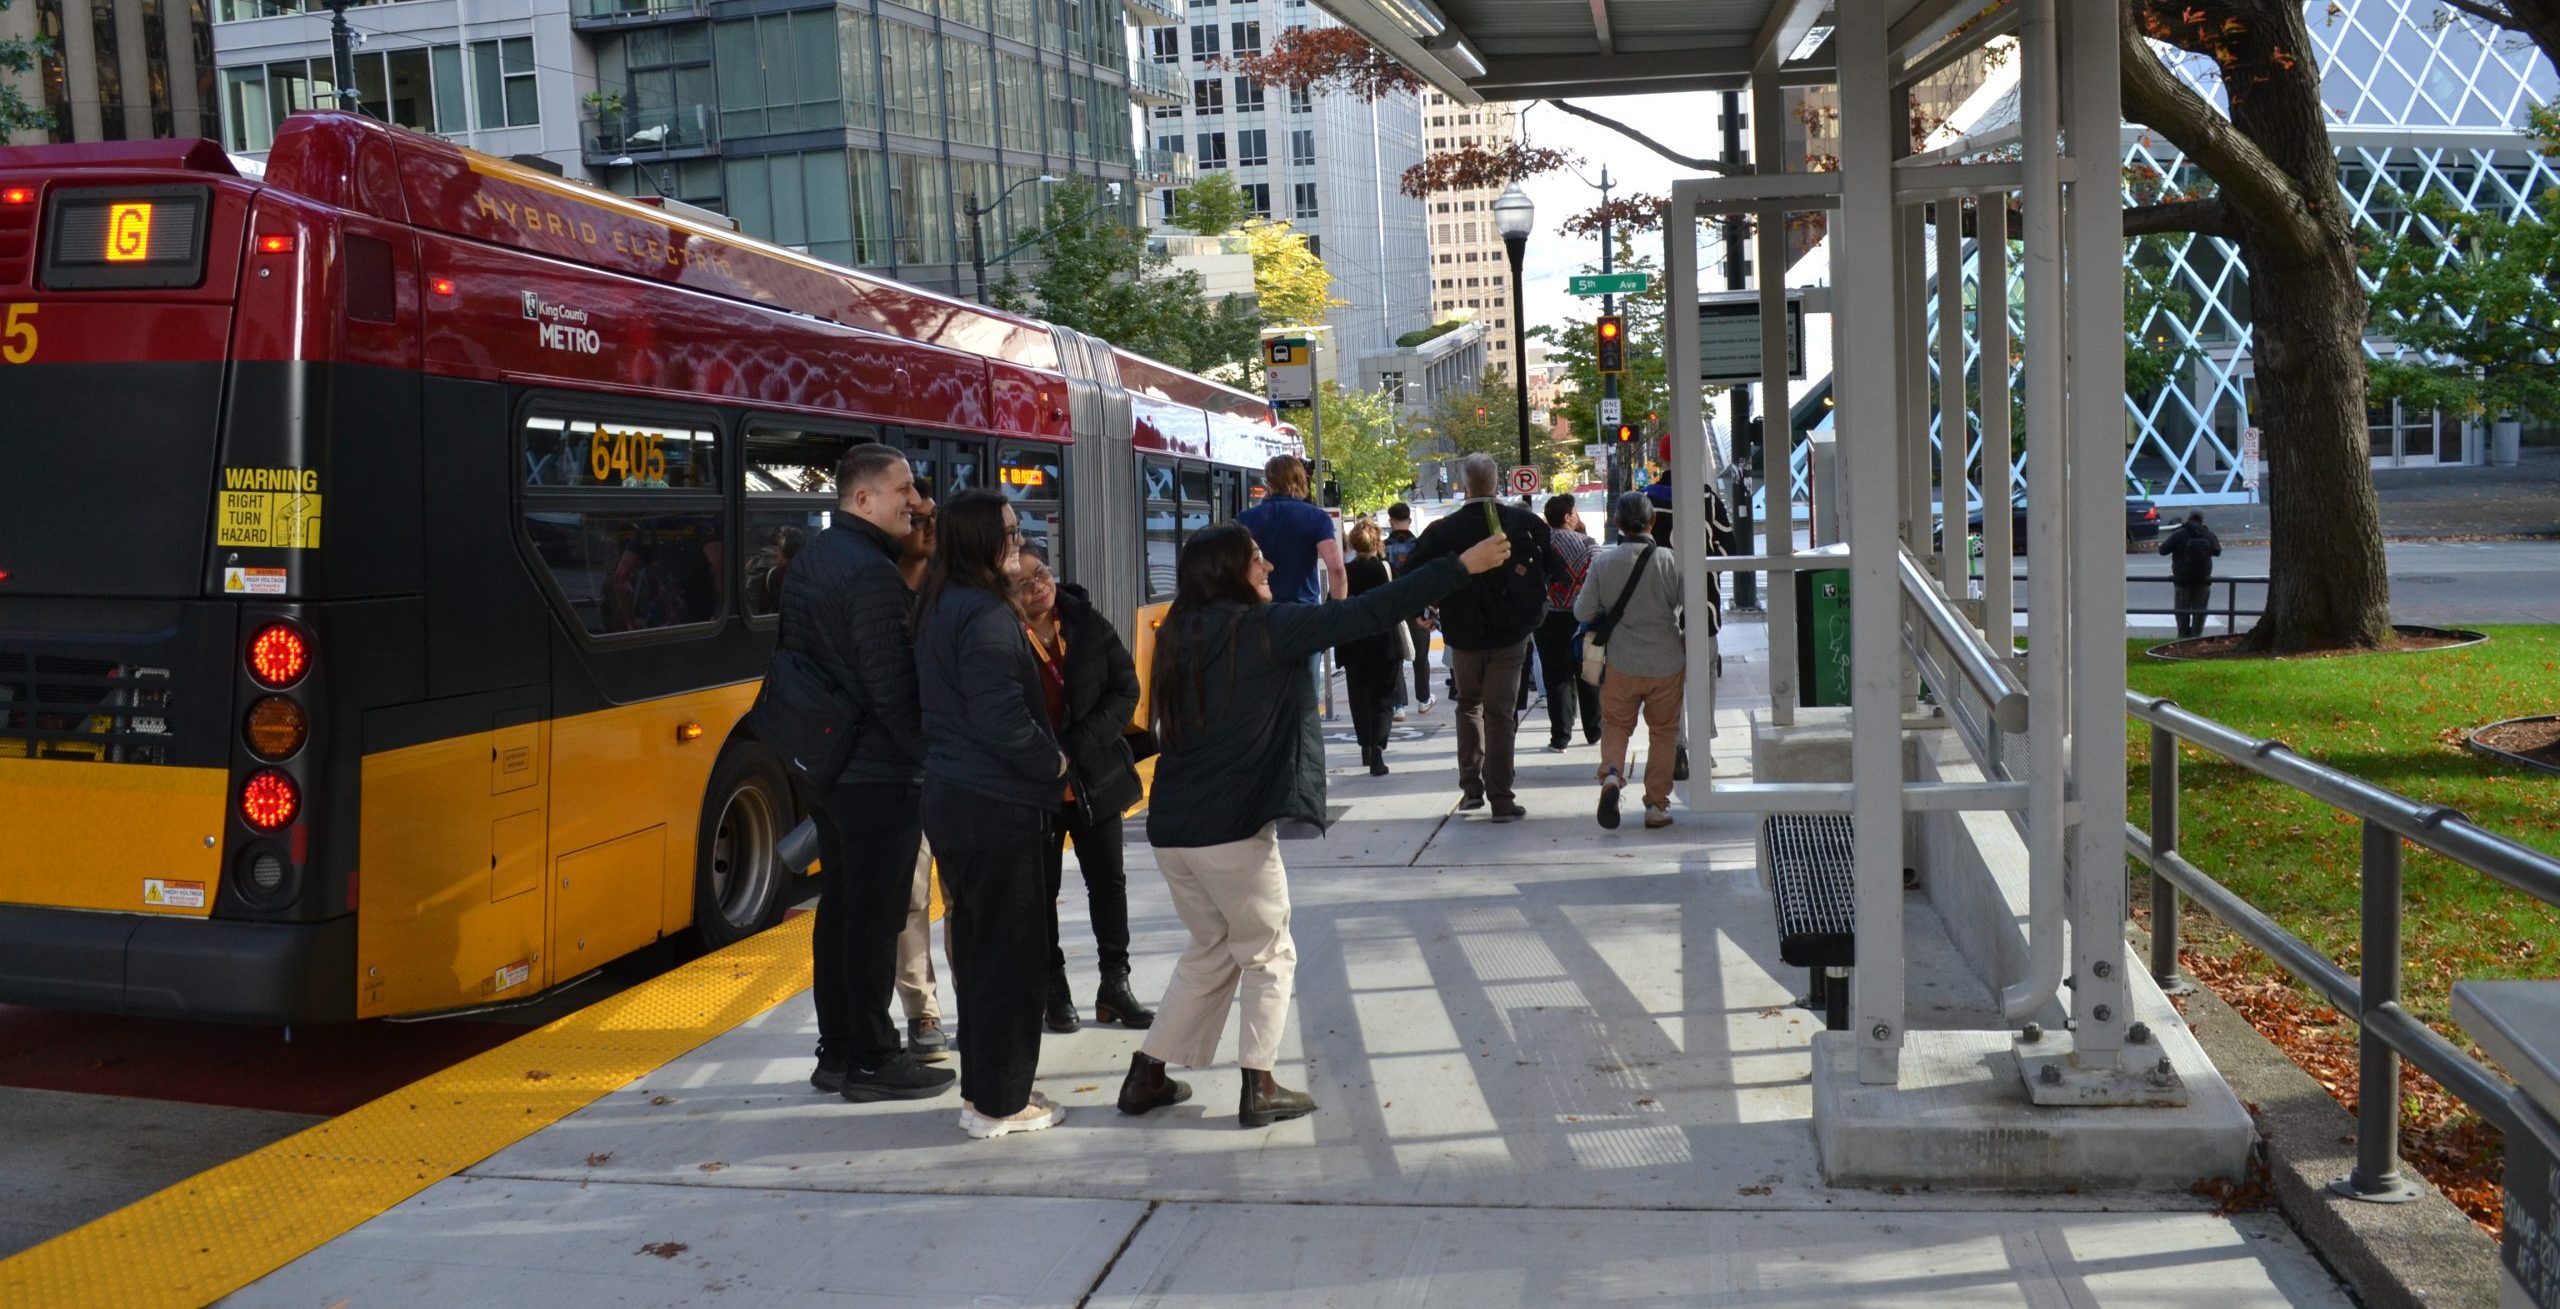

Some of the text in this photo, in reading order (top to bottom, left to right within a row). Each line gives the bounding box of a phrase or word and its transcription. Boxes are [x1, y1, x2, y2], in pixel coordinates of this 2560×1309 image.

[113, 206, 146, 257] G
[476, 194, 735, 280] HYBRID ELECTRIC
[1578, 279, 1637, 291] 5th Ave
[539, 301, 589, 325] King County
[0, 302, 39, 365] 5
[538, 322, 600, 356] METRO
[1603, 400, 1619, 408] ONE
[591, 428, 666, 481] 6405
[225, 468, 318, 491] WARNING
[228, 494, 264, 509] RIGHT
[229, 511, 261, 526] TURN
[221, 527, 267, 543] HAZARD
